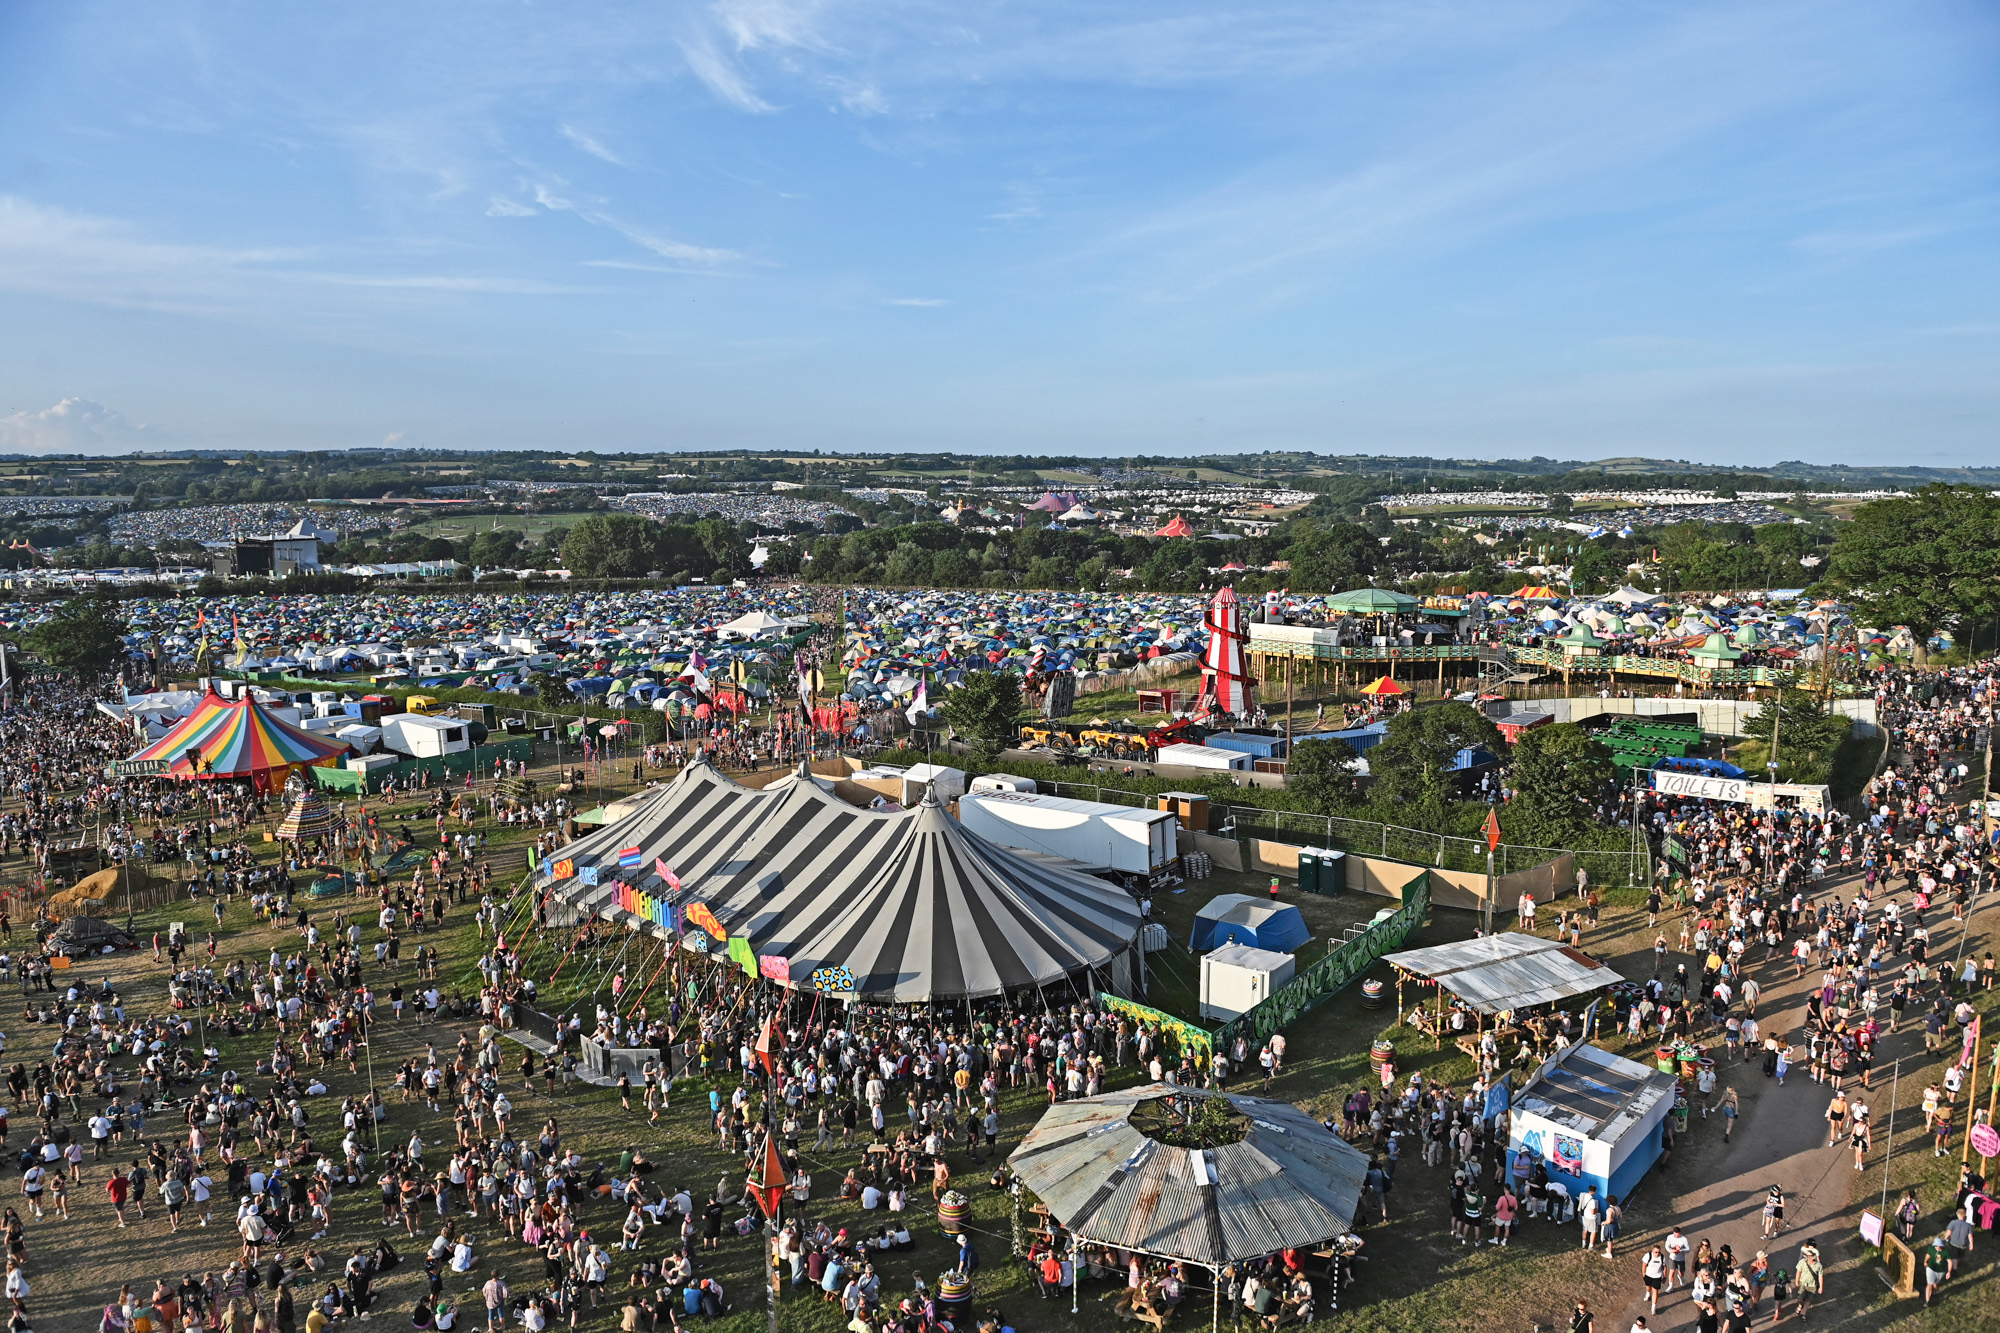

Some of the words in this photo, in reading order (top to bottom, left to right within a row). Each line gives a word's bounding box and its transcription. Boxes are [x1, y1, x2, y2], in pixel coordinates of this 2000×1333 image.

[1424, 597, 1462, 610] ALLEY
[121, 762, 140, 774] PARK
[144, 760, 159, 771] BAR
[1663, 775, 1740, 799] TOILETS
[611, 879, 686, 935] STONEBRIDGE
[1975, 1144, 1993, 1156] WORLD
